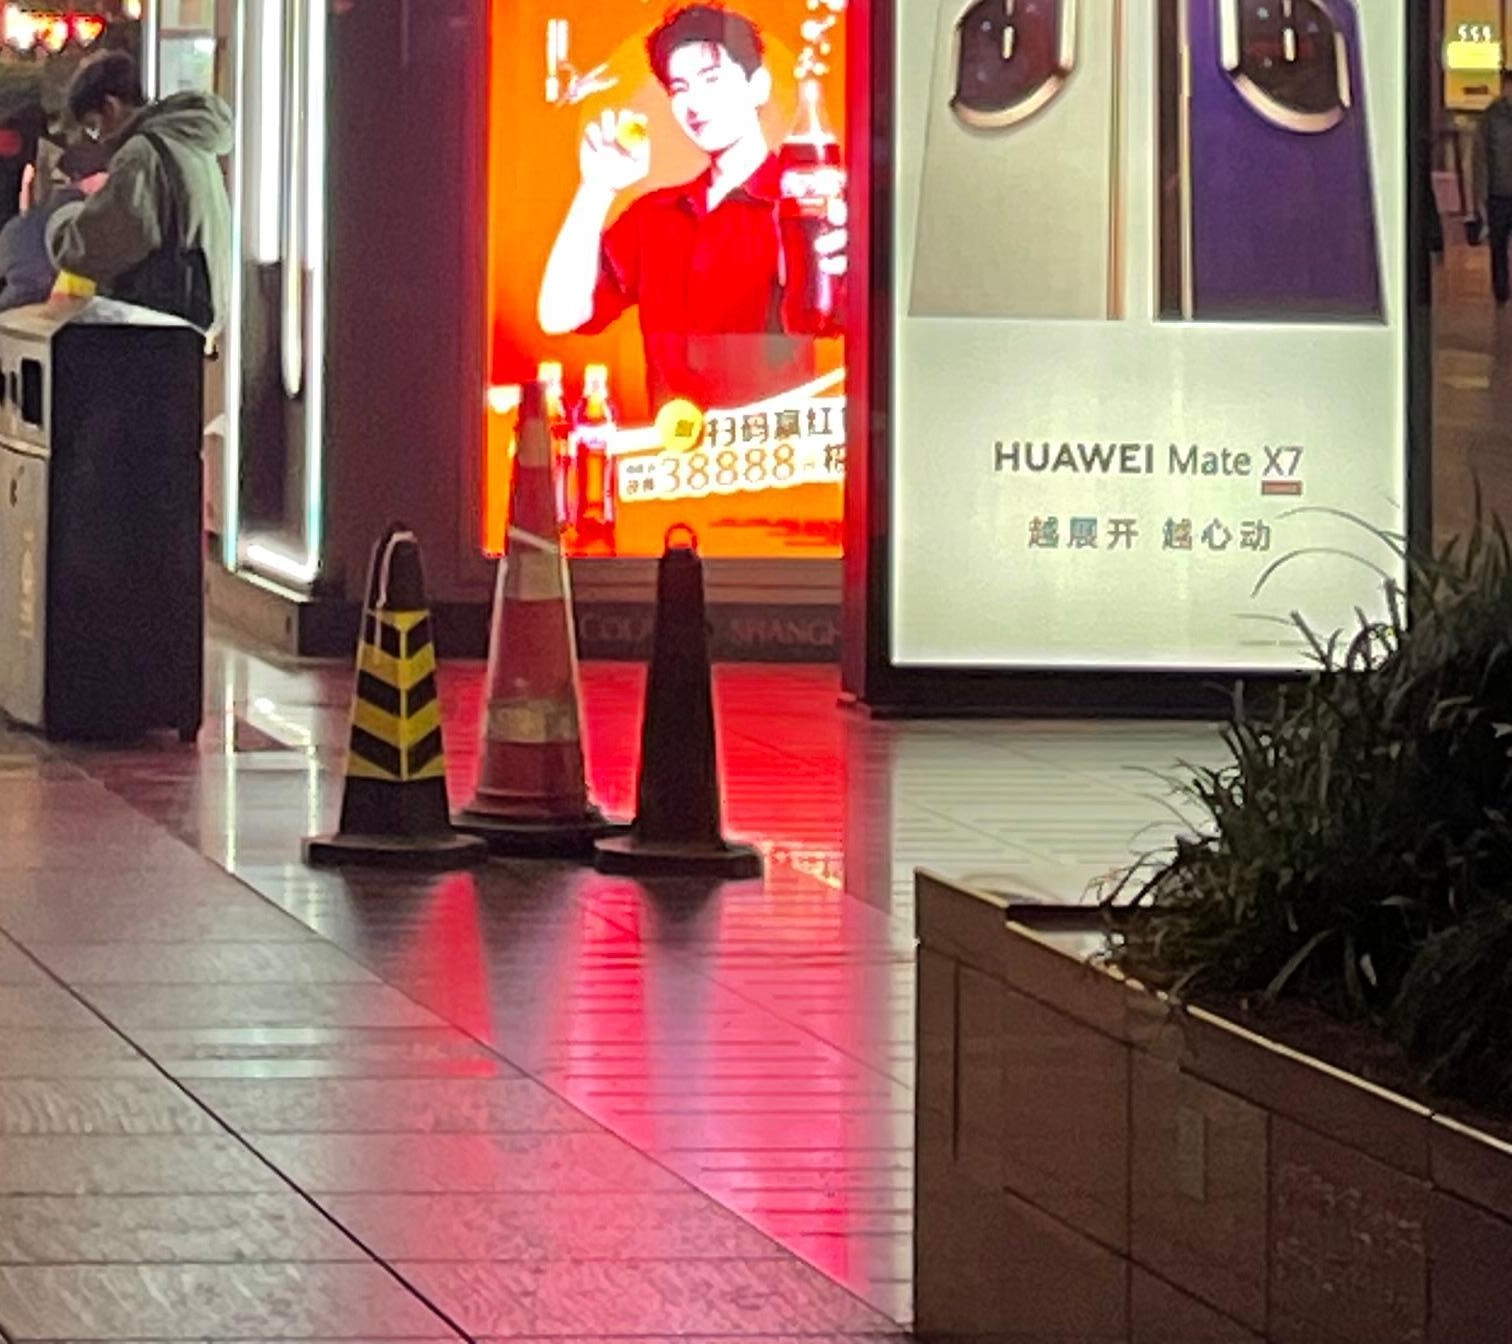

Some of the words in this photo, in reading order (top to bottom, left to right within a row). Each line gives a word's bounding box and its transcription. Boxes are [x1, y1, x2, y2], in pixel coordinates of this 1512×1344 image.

[708, 407, 846, 448] 扫码赢红
[661, 443, 796, 493] 38888
[994, 441, 1154, 474] HUAWEI
[1168, 444, 1252, 476] Mate
[1263, 445, 1304, 477] X7
[1028, 515, 1139, 550] 越展开
[1162, 517, 1272, 551] 越心动
